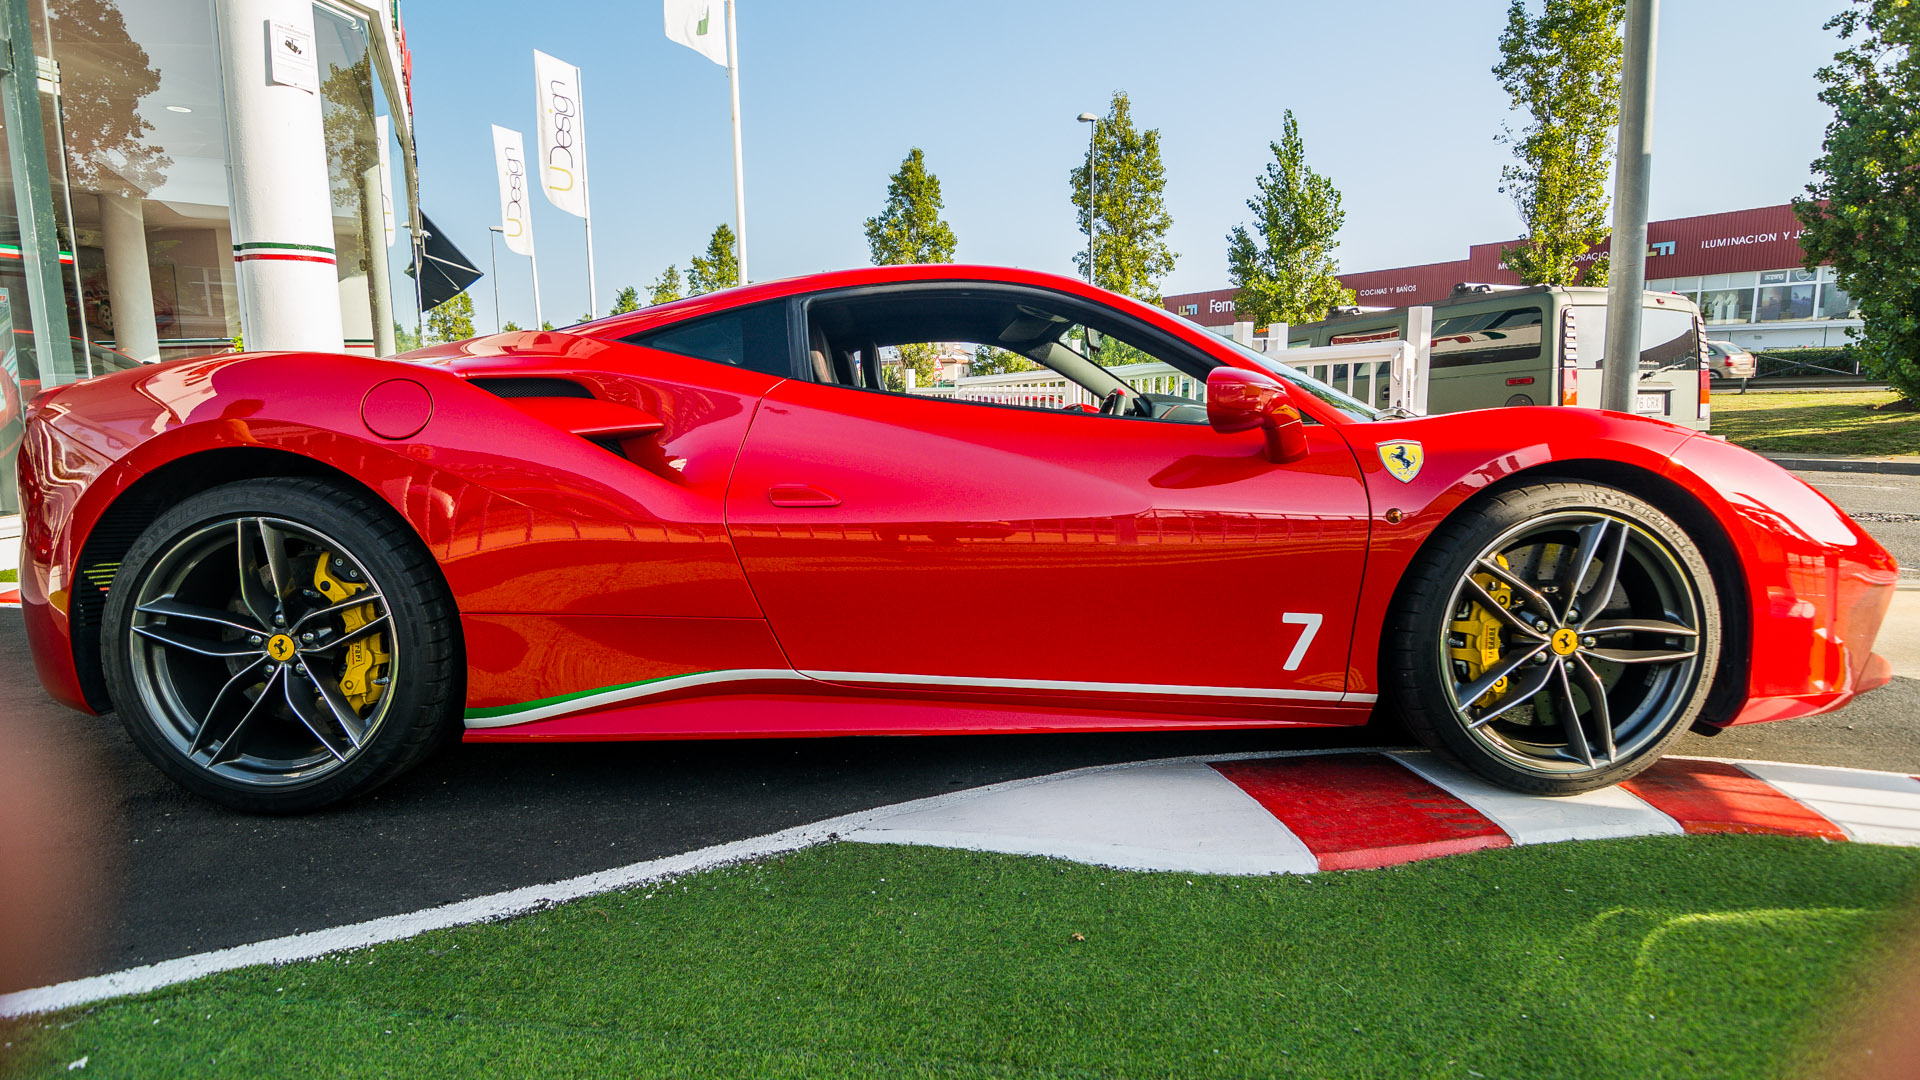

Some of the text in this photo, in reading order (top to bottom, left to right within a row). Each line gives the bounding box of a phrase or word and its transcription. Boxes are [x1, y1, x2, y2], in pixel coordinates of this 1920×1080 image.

[1701, 232, 1777, 249] ILUMINACION
[1783, 231, 1790, 240] Y
[1360, 288, 1387, 296] COCINAS
[1282, 612, 1323, 671] 7
